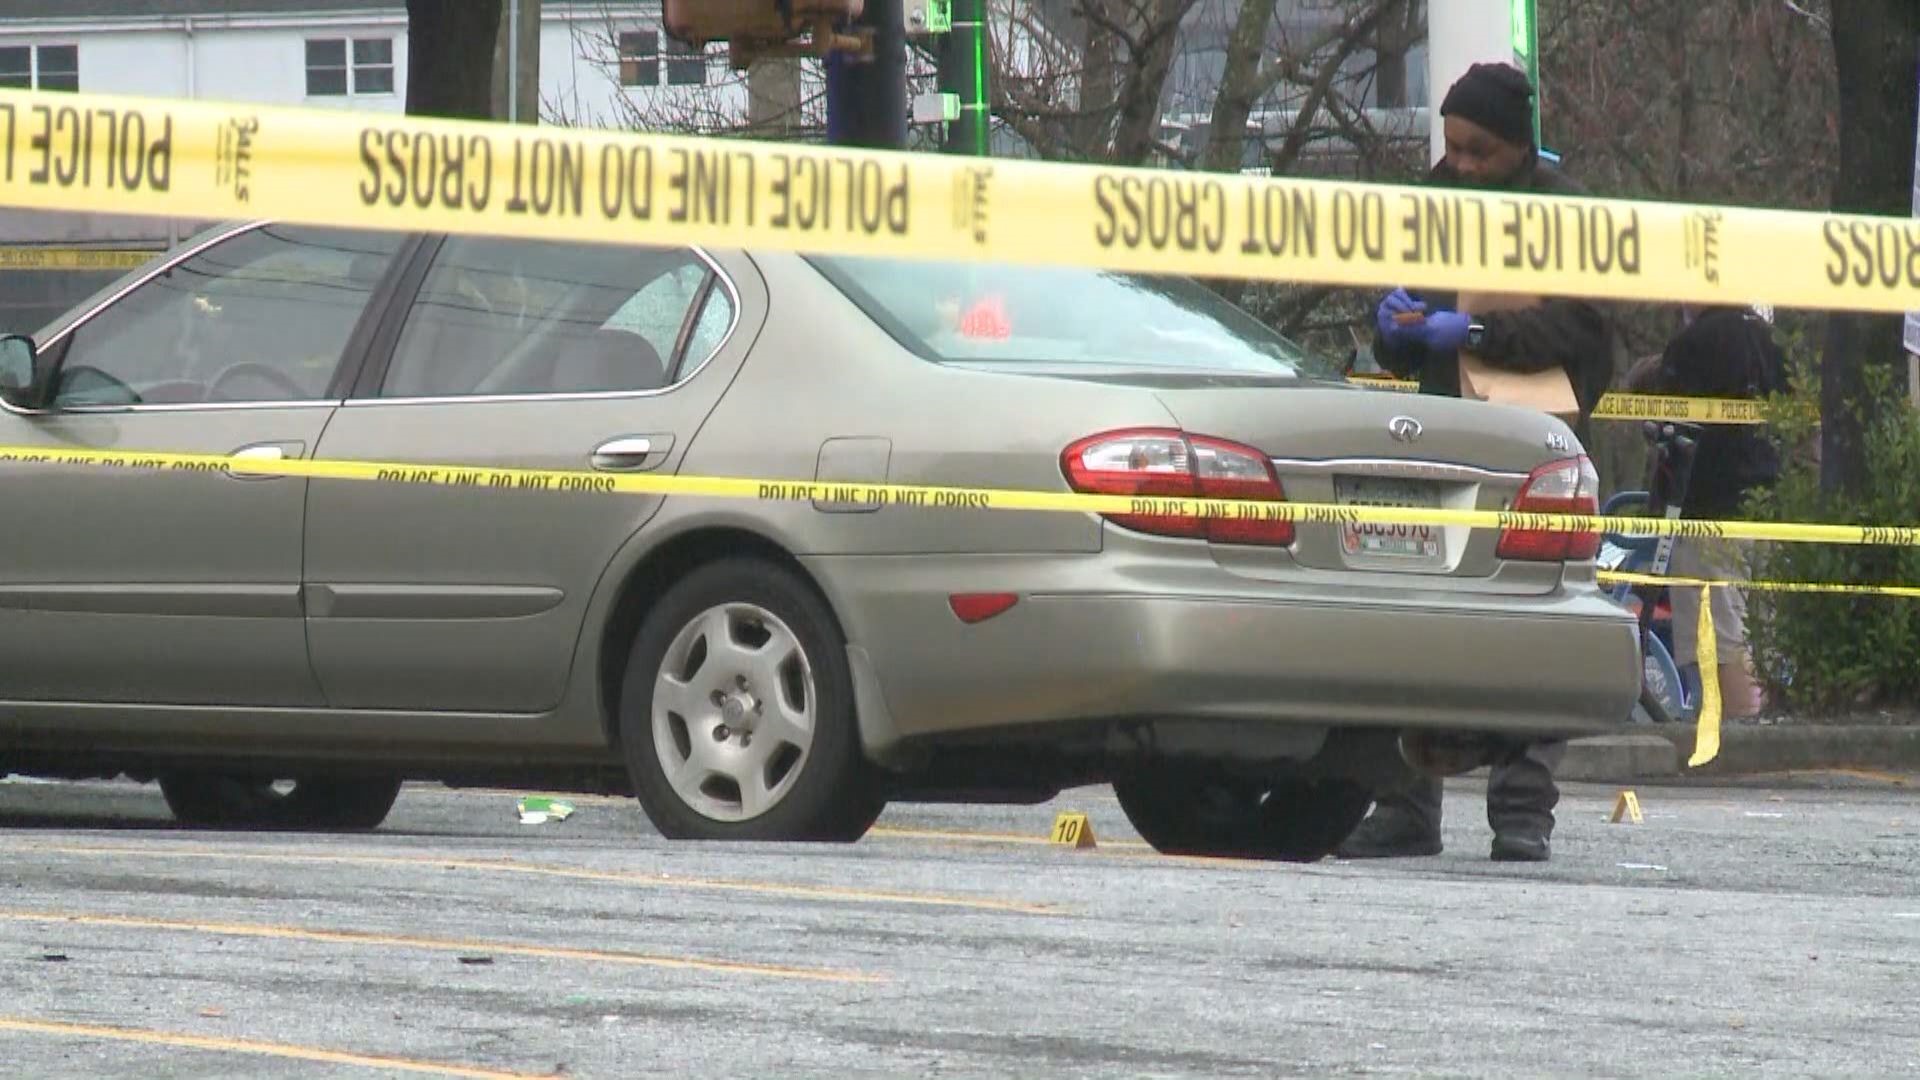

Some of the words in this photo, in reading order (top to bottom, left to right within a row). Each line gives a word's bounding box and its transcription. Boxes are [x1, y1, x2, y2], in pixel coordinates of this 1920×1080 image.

[29, 104, 172, 192] POLICE
[359, 128, 493, 213] CROSS
[505, 138, 585, 216] NOT
[600, 143, 653, 221] DO
[668, 148, 756, 227] LINE
[771, 154, 909, 235] POLICE
[1094, 175, 1226, 254] CROSS
[1241, 184, 1318, 258] NOT
[1332, 187, 1385, 262] DO
[1401, 194, 1488, 269] LINE
[1502, 200, 1641, 276] POLICE
[1823, 219, 1920, 289] ROSS
[1663, 399, 1689, 418] CROSS
[1058, 819, 1077, 843] 10
